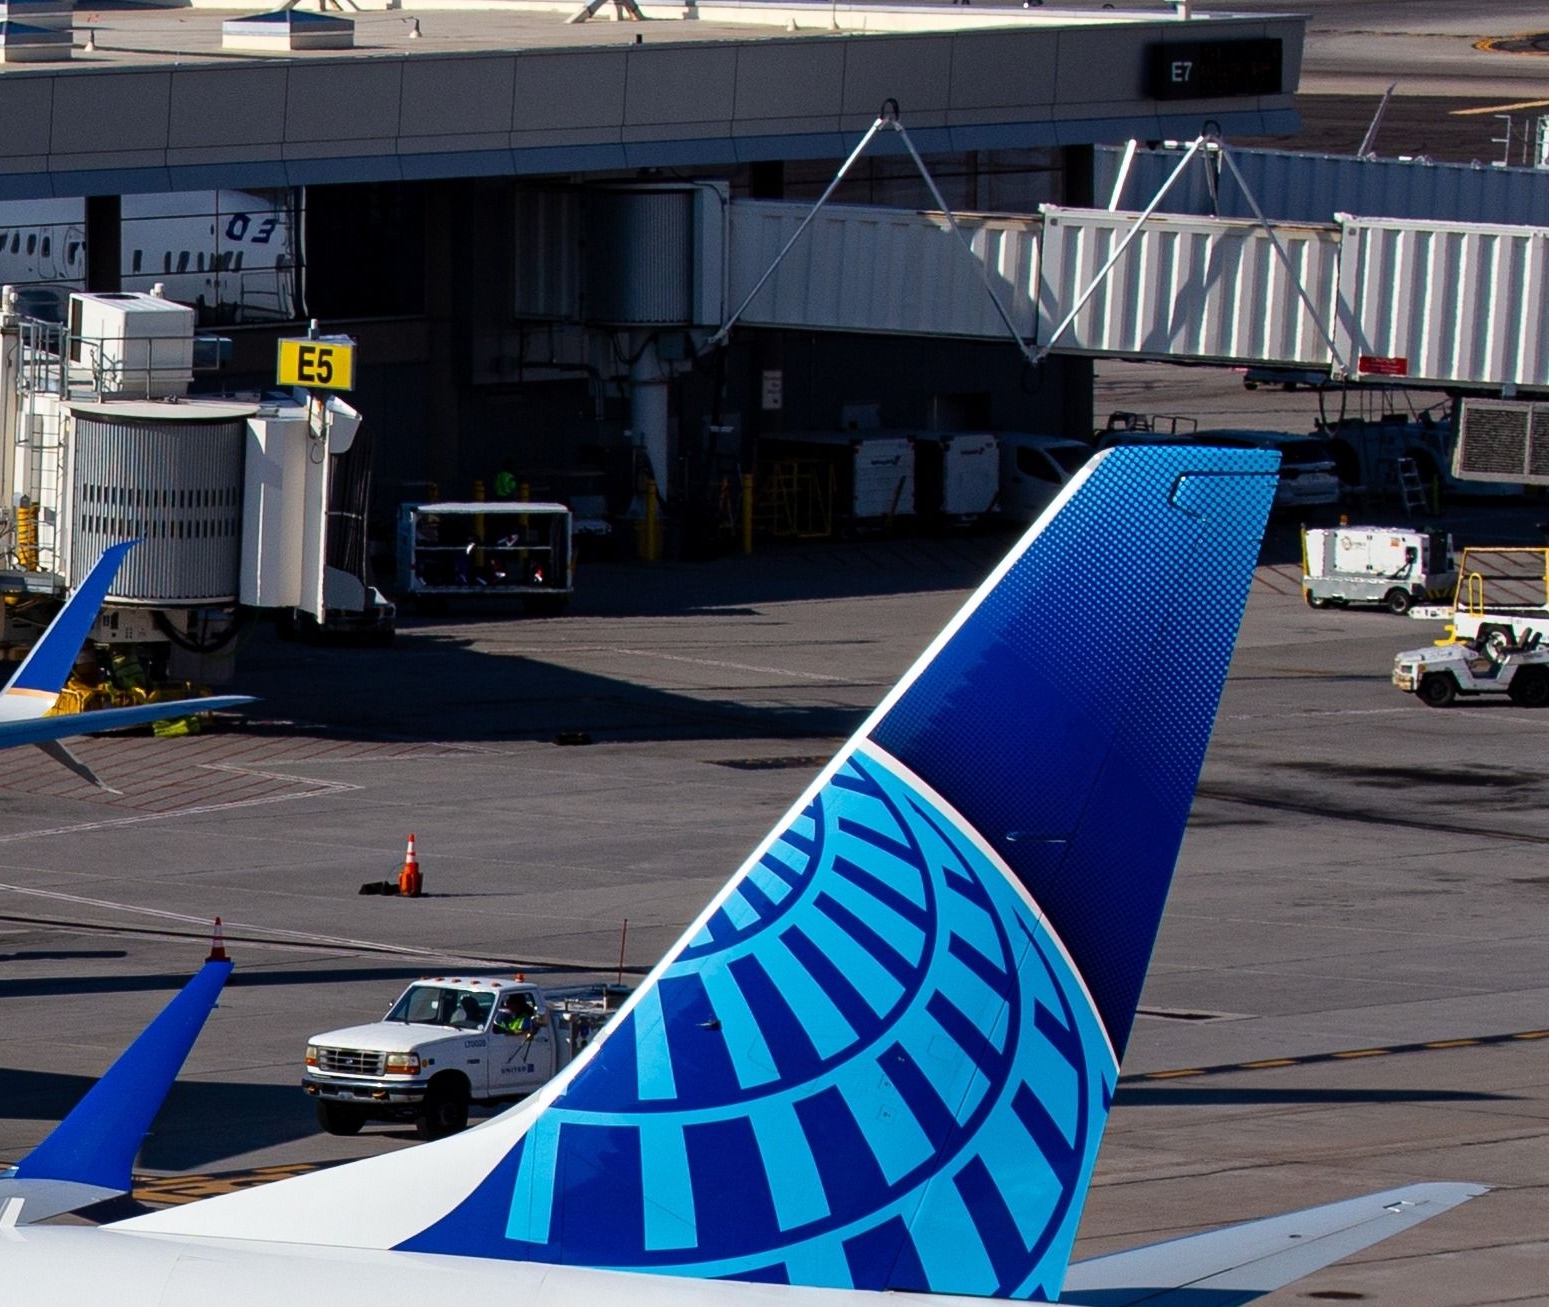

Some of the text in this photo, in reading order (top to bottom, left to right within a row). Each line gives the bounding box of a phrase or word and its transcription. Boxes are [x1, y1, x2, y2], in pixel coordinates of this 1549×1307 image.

[1171, 61, 1192, 82] E7
[298, 345, 333, 384] E5
[501, 1065, 527, 1074] UNITED
